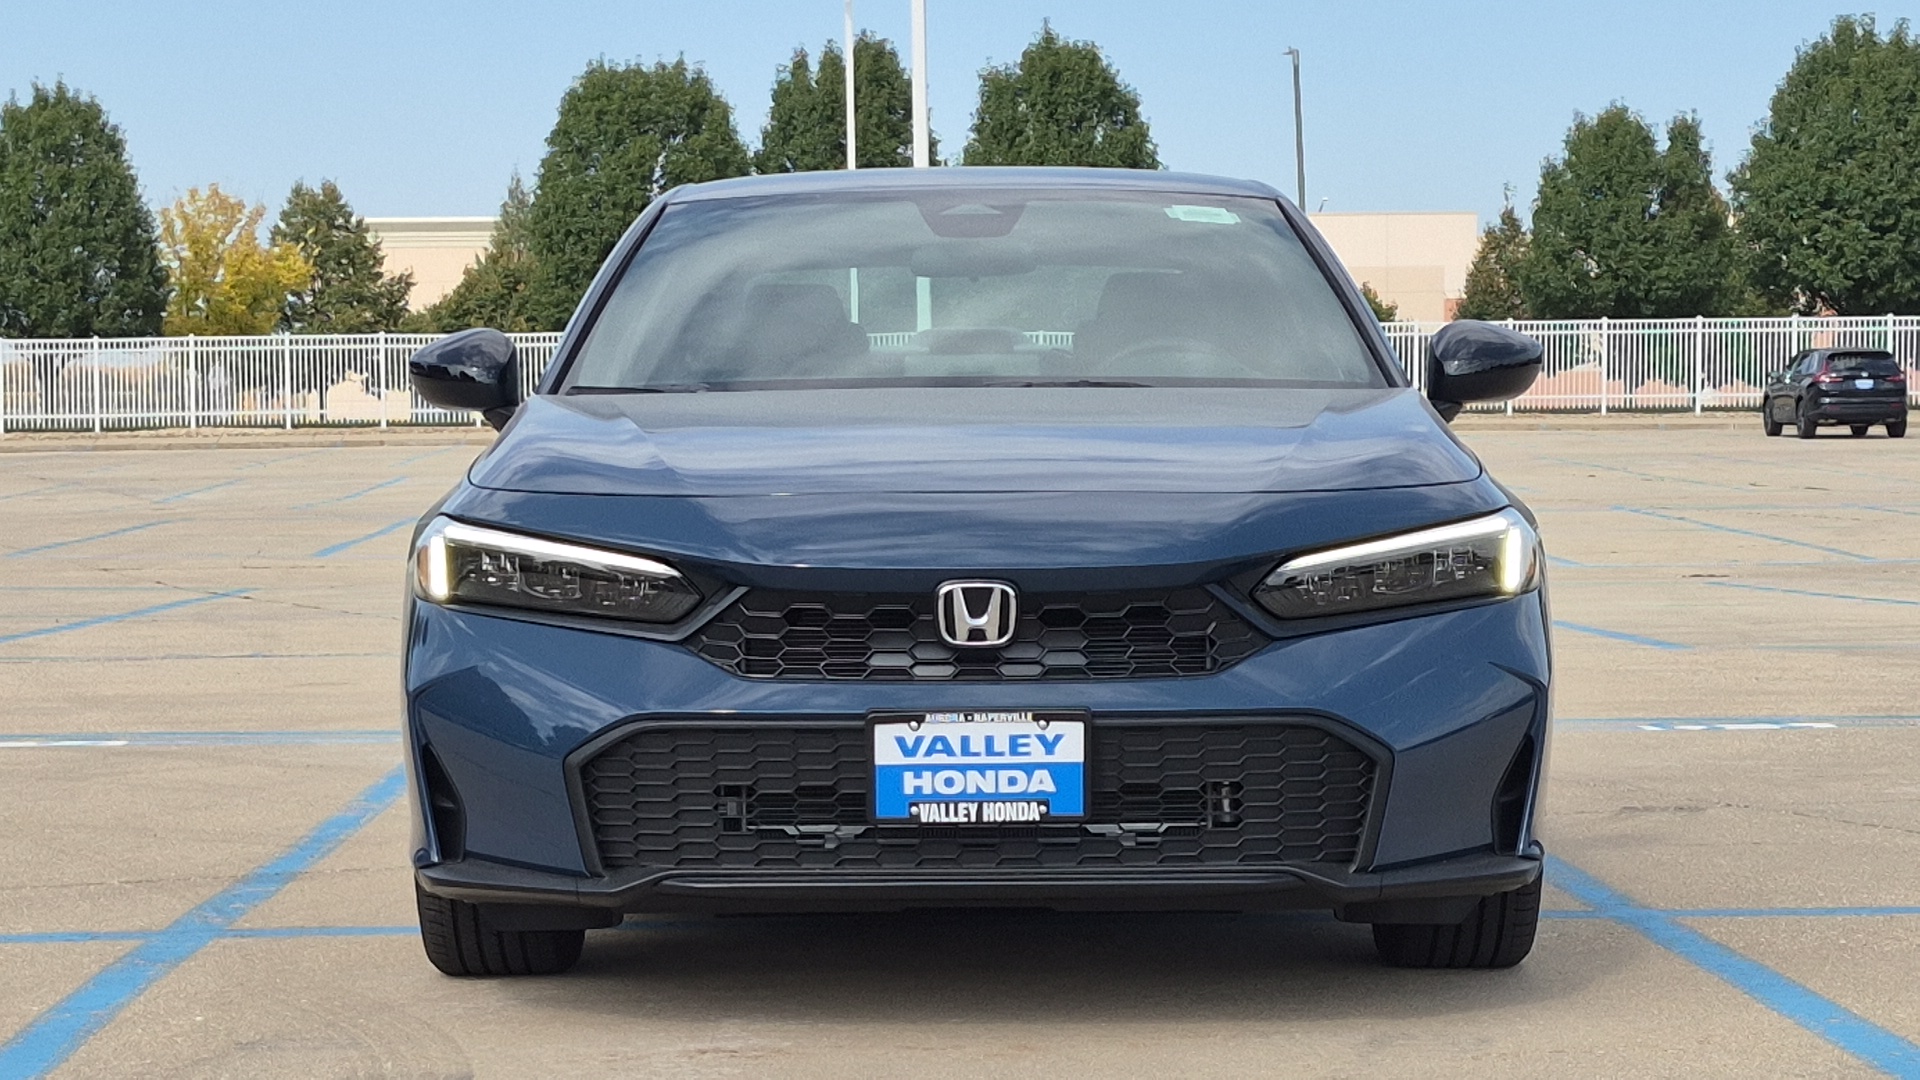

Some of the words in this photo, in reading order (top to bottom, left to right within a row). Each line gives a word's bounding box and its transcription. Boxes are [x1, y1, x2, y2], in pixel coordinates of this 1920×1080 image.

[894, 734, 1065, 758] VALLEY
[903, 769, 1056, 795] HONDA
[919, 802, 979, 823] VALLEY
[982, 802, 1041, 822] HONDA
